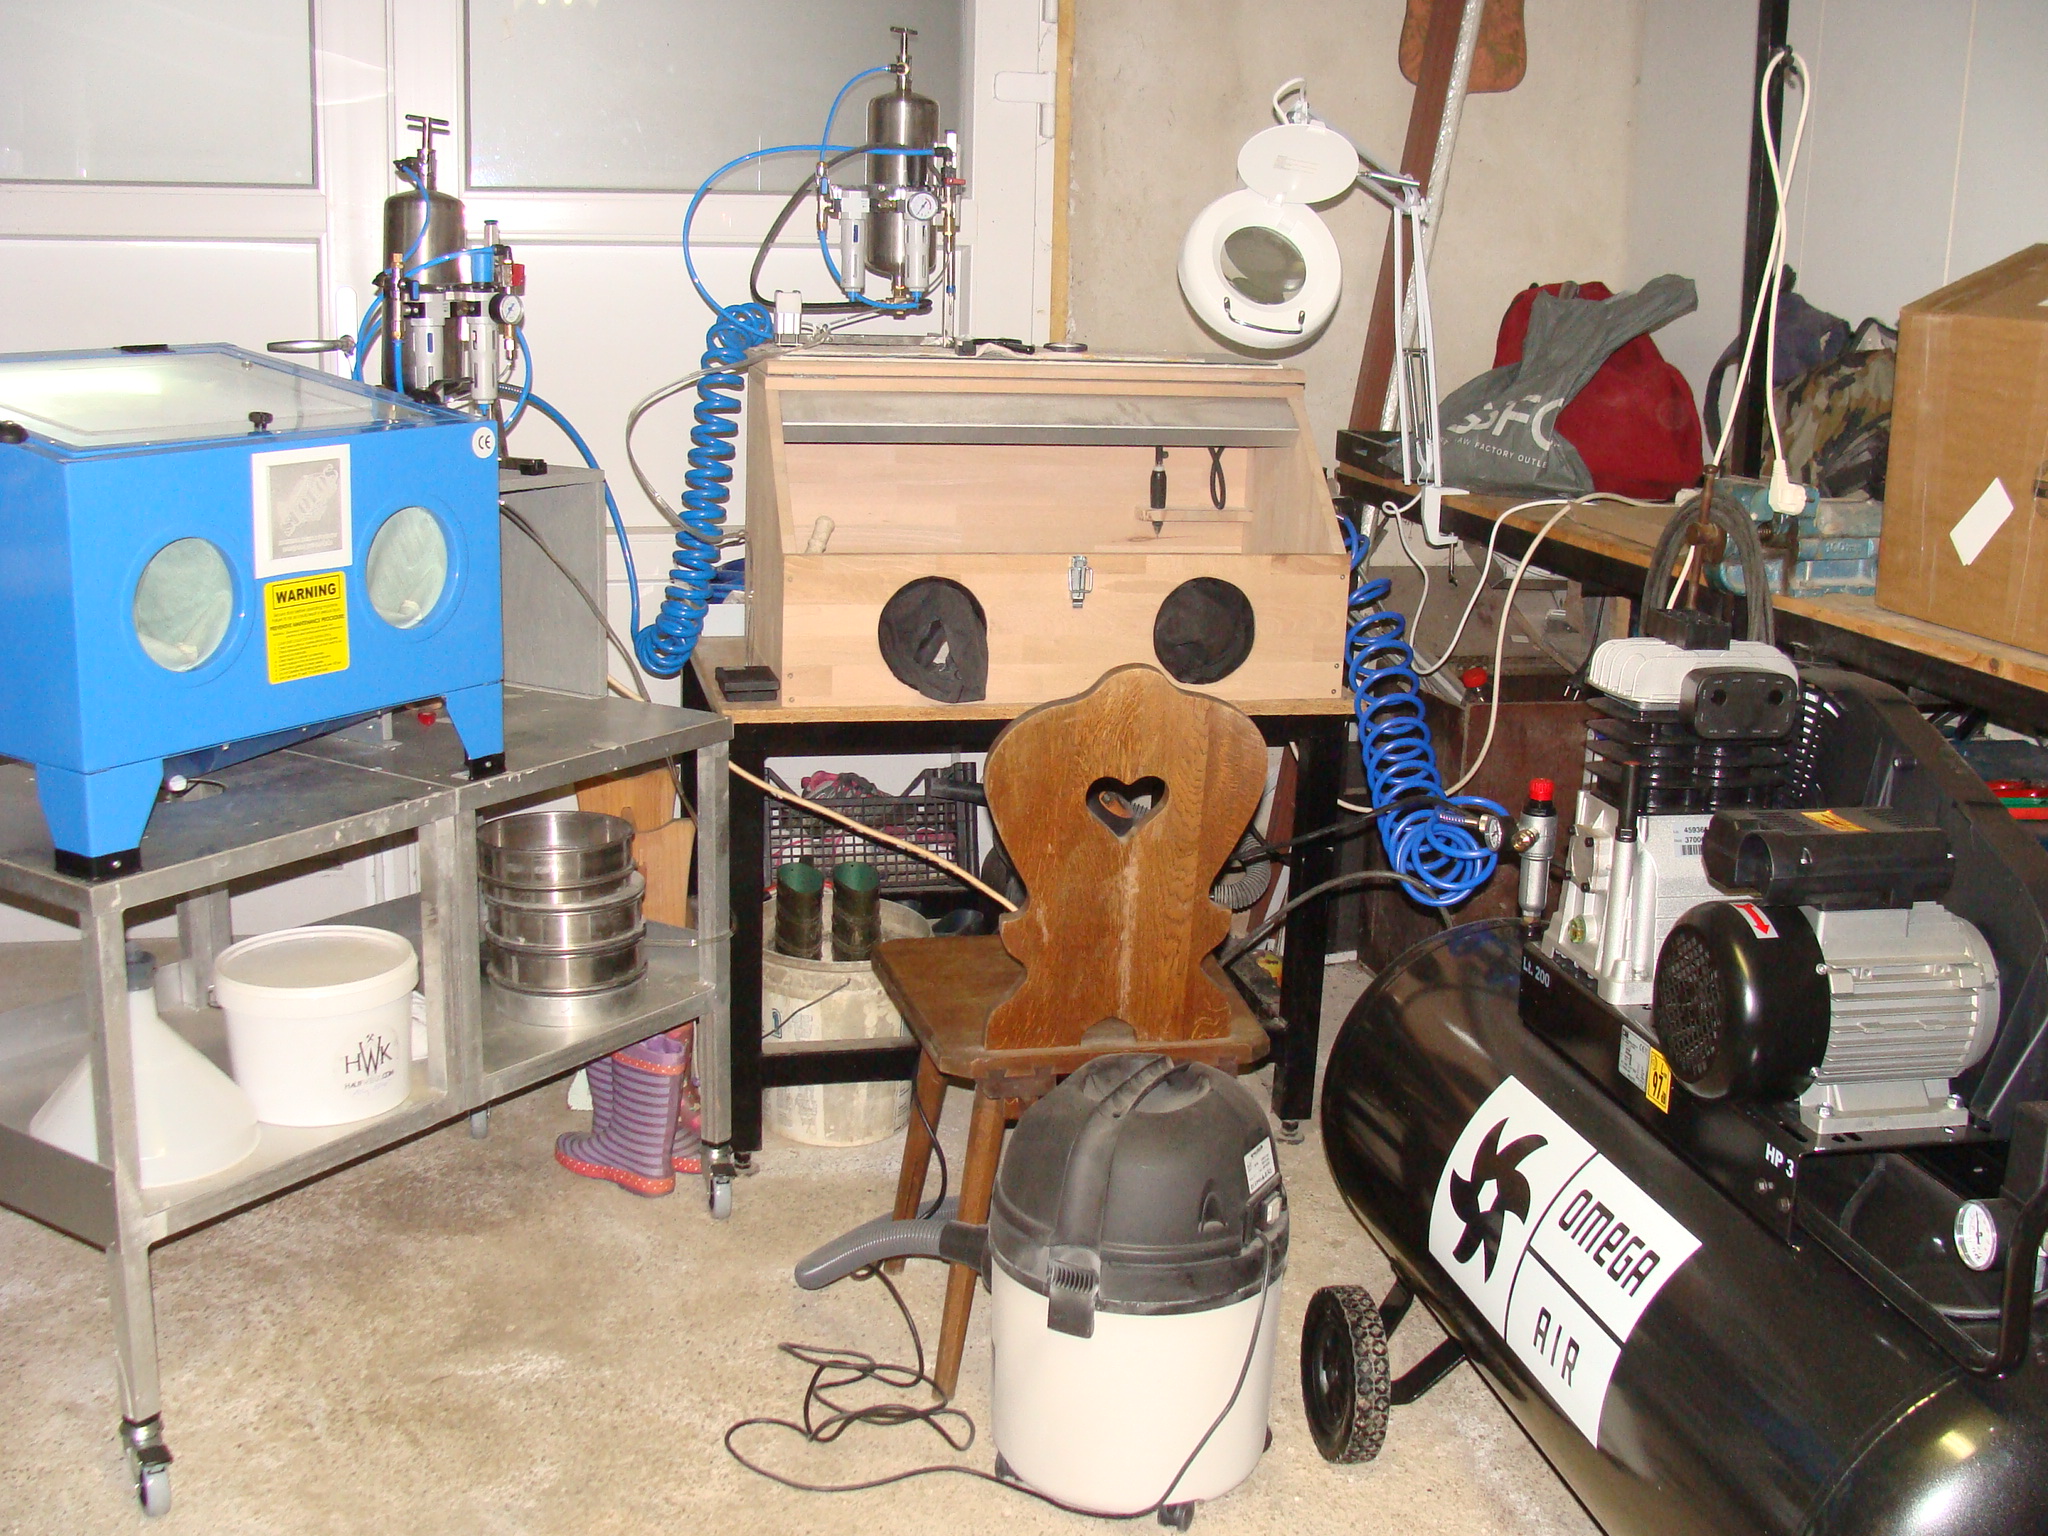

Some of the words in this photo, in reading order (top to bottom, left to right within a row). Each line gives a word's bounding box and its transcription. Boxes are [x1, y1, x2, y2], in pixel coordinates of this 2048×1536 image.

[478, 434, 491, 450] CE
[1474, 442, 1514, 459] FACTORY
[1517, 454, 1548, 469] OUTLE
[276, 583, 336, 603] WARNING
[1535, 965, 1550, 988] 200
[345, 1035, 393, 1077] HWK
[1652, 1071, 1664, 1100] 97
[1765, 1142, 1784, 1168] HP
[1785, 1158, 1795, 1179] 3
[1558, 1189, 1660, 1297] OMEGA
[1533, 1306, 1580, 1388] AIR
